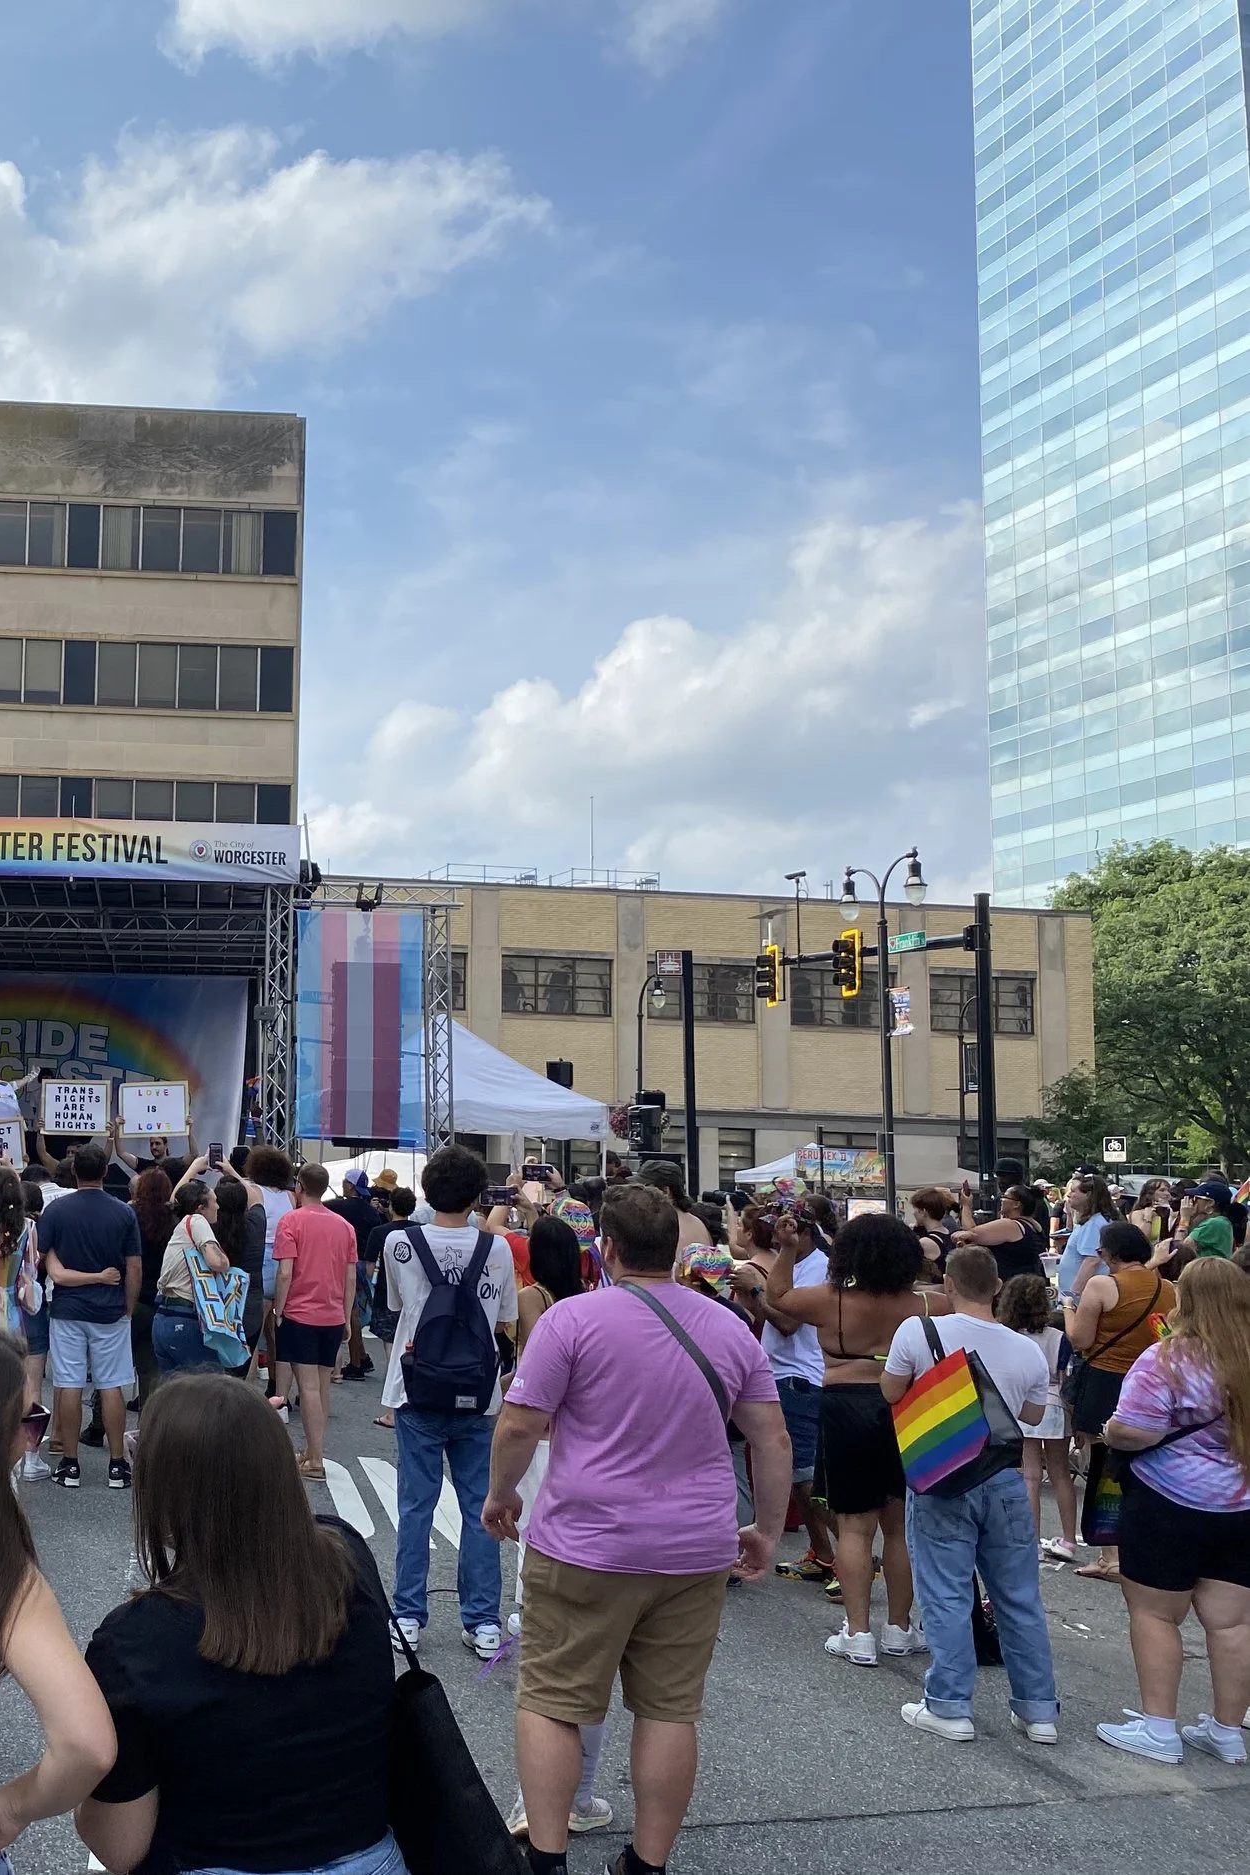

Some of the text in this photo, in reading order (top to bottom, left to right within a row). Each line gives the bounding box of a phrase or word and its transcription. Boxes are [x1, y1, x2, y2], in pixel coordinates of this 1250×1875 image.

[52, 832, 168, 865] FESTIVAL
[214, 840, 254, 849] The City of
[214, 850, 287, 866] WORCESTER
[895, 934, 920, 949] Franklin
[57, 1086, 94, 1095] TRANS
[55, 1095, 100, 1103] RIGHTS
[63, 1103, 85, 1111] ARE
[147, 1105, 157, 1113] IS
[55, 1112, 93, 1121] HUMAN
[55, 1121, 96, 1130] RIGHTS
[138, 1123, 170, 1131] LOVE
